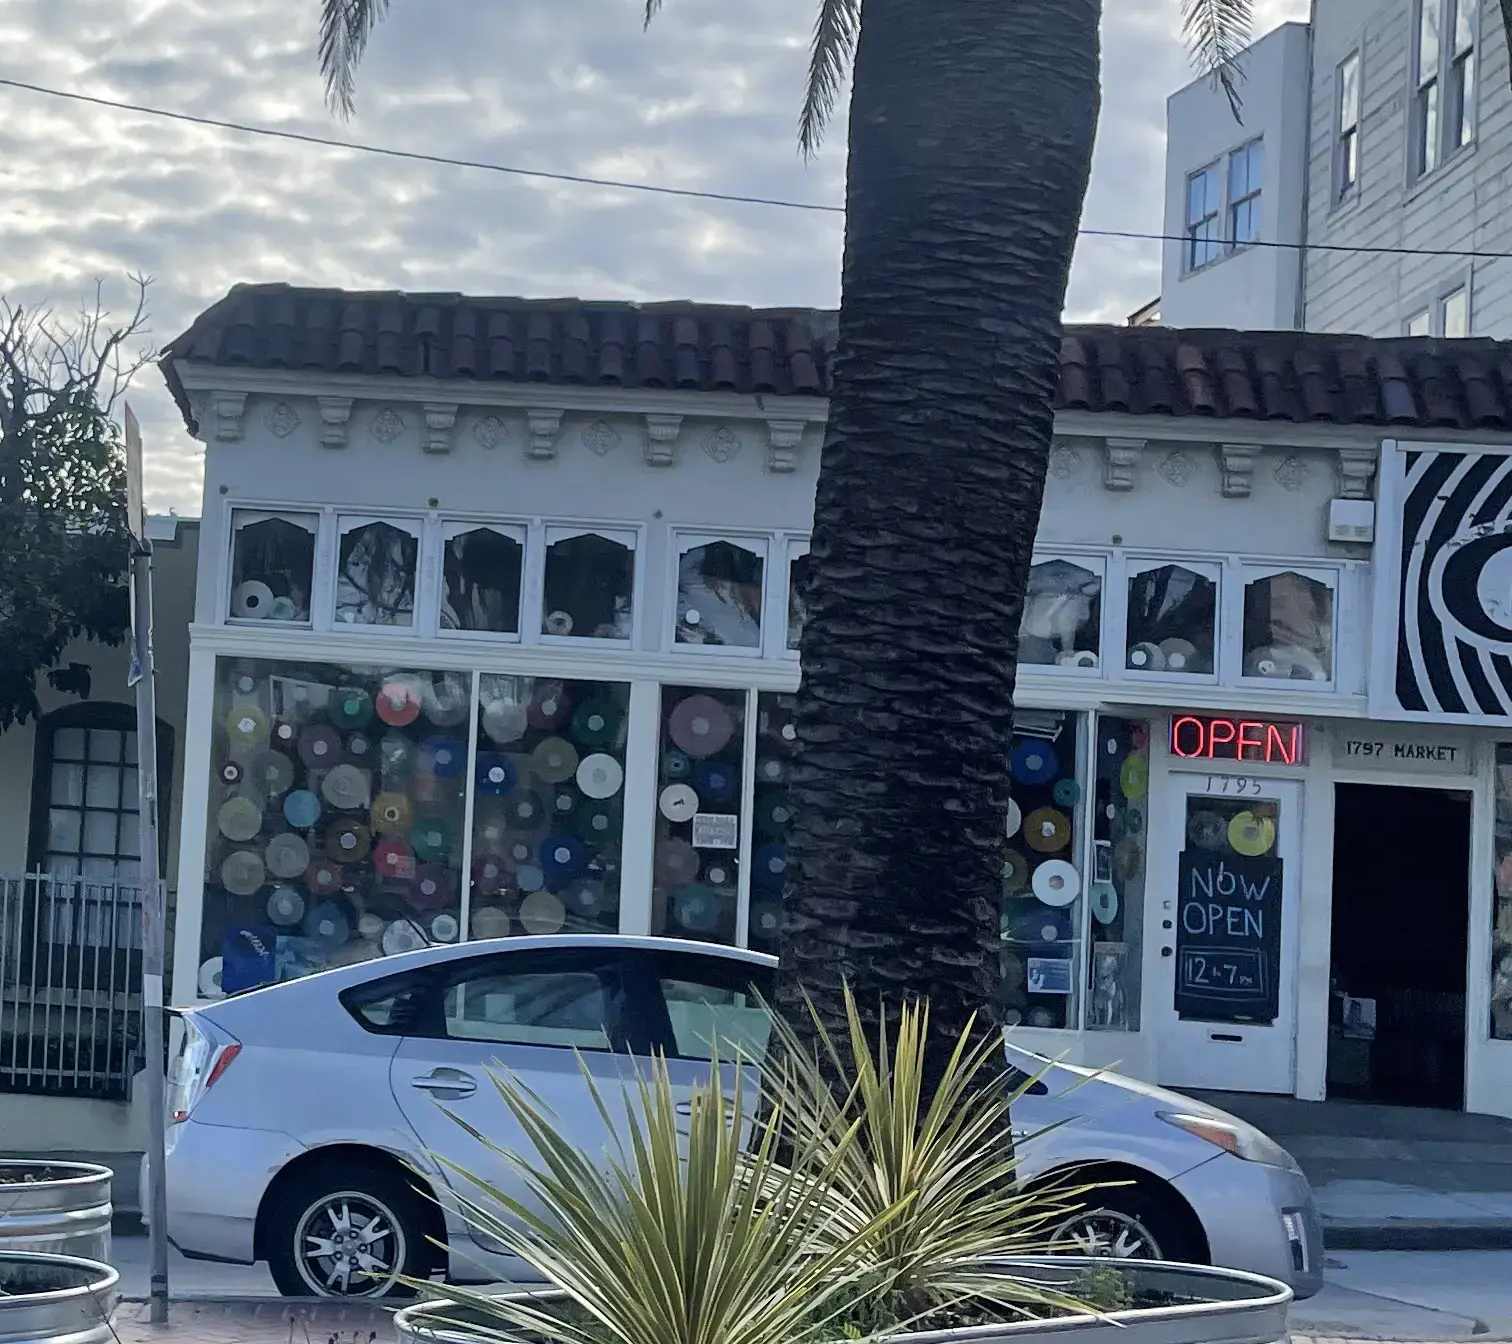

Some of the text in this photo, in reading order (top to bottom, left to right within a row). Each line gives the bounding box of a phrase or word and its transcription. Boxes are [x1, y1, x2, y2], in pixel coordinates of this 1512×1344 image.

[1173, 717, 1298, 764] OPEN
[1346, 741, 1457, 762] 1797 MARKET
[1191, 861, 1271, 901] NOW
[1183, 902, 1263, 939] OPEN
